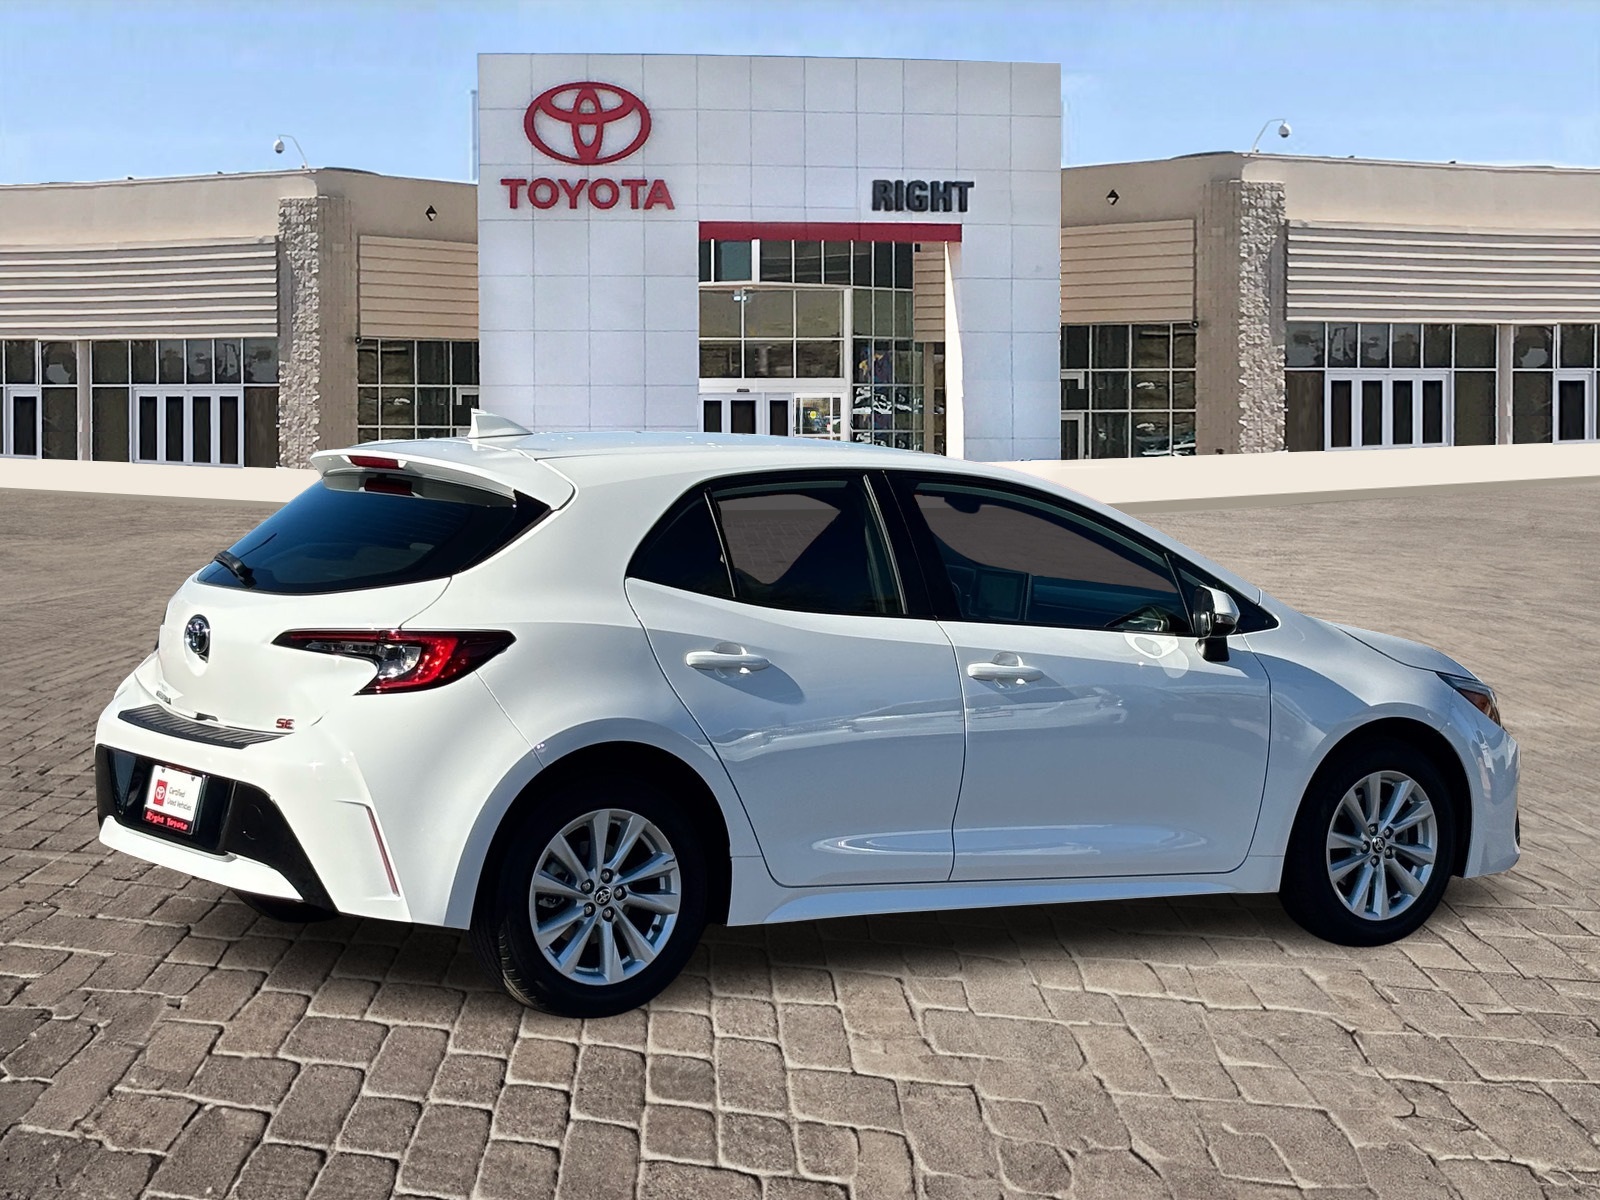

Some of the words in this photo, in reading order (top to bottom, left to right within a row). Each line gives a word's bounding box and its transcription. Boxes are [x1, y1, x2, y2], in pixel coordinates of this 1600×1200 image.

[500, 177, 676, 210] TOYOTA
[872, 179, 975, 213] RIGHT
[276, 718, 295, 730] SE
[145, 811, 165, 824] Right
[167, 817, 188, 830] Toyota
